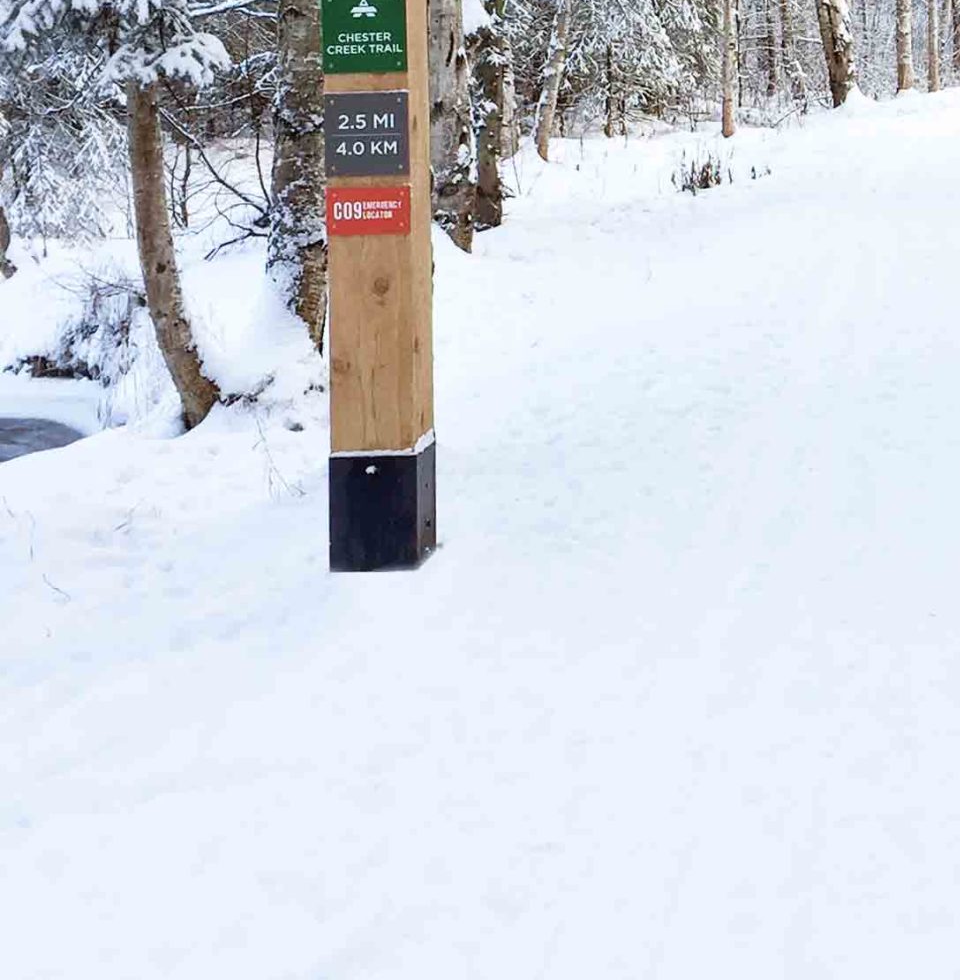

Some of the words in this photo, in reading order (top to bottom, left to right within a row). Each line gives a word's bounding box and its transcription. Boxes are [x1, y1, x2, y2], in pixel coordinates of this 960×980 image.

[338, 32, 391, 42] CHESTER
[327, 45, 365, 55] CREEK
[369, 44, 403, 53] TRAIL
[338, 114, 367, 129] 2.5
[373, 114, 394, 129] MI
[336, 141, 365, 155] 4.0
[371, 141, 397, 154] KM
[334, 202, 362, 220] C09
